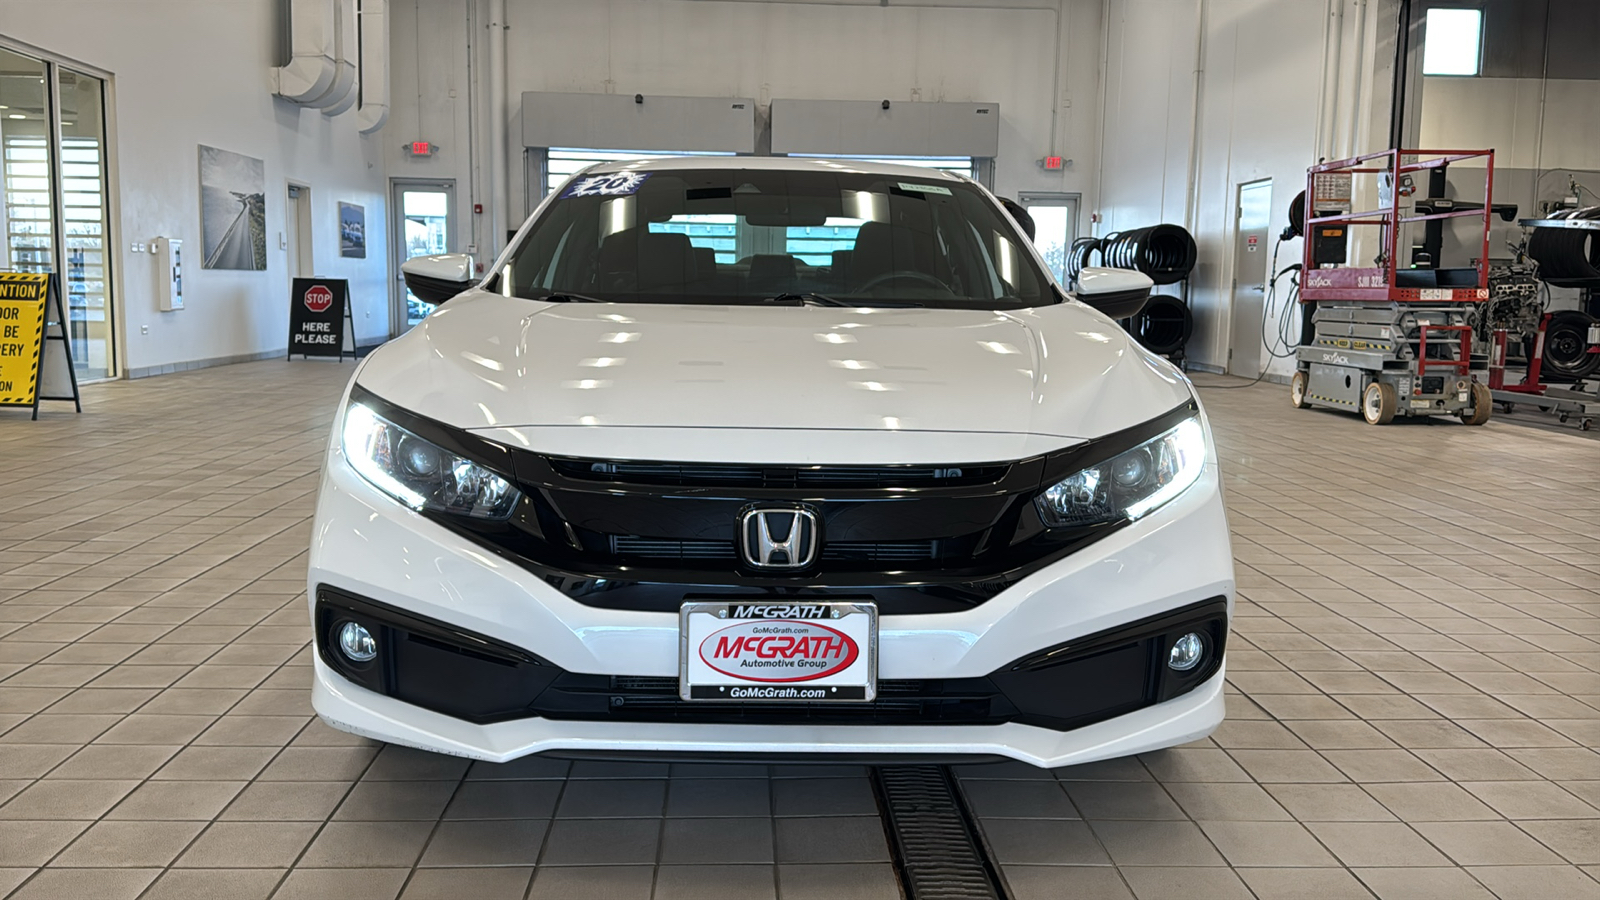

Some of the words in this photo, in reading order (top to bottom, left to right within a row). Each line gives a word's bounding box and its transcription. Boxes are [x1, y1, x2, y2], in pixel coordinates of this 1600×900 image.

[412, 142, 429, 154] EXIT
[1046, 156, 1061, 169] EXIT
[583, 177, 629, 191] 20
[1307, 276, 1332, 288] SKYJACK
[306, 293, 331, 304] STOP
[4, 325, 19, 338] BE
[302, 322, 331, 332] HERE
[294, 333, 337, 345] PLEASE
[1322, 352, 1349, 364] SKYJACK
[740, 659, 795, 668] Automotive
[797, 659, 827, 669] Group
[730, 687, 826, 698] GoMcGrath.com
